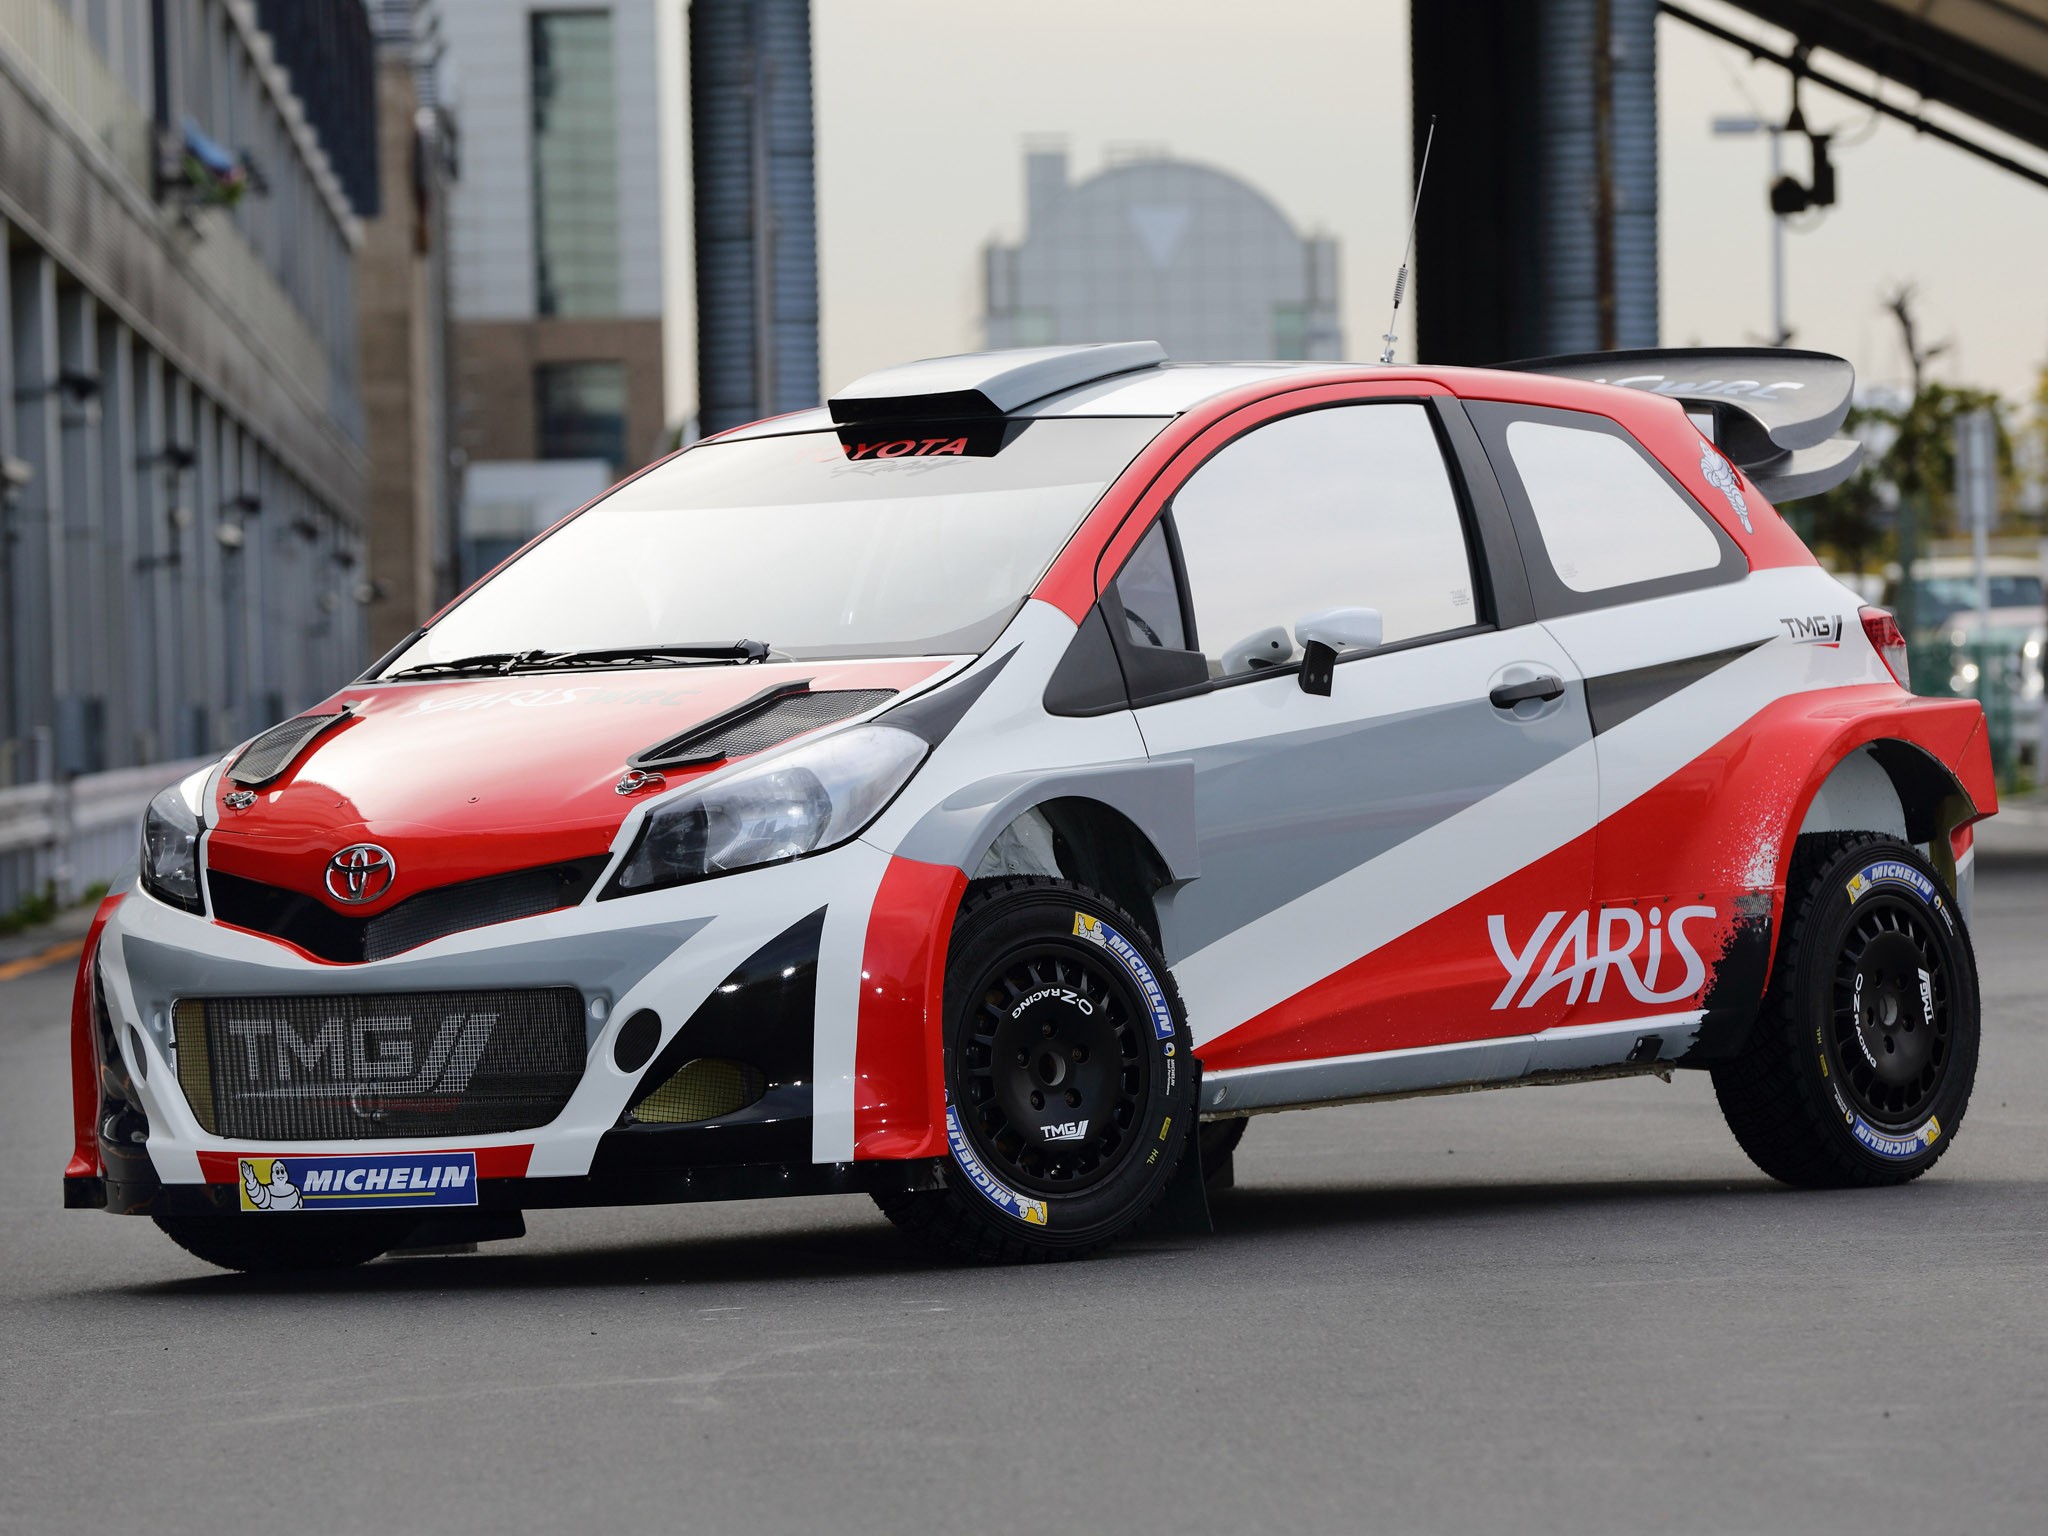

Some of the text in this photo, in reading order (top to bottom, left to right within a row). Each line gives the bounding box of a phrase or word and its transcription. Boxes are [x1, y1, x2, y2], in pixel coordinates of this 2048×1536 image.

[1780, 615, 1830, 639] TMG
[1871, 864, 1933, 897] MICHELIN
[1108, 934, 1172, 1032] MICHELIN
[1012, 988, 1060, 1019] RACING
[229, 1015, 413, 1081] TMG
[1853, 1013, 1877, 1068] RACING
[1855, 1124, 1918, 1156] MICHELIN
[946, 1113, 1013, 1207] MICHELIN
[303, 1165, 471, 1192] MICHELIN
